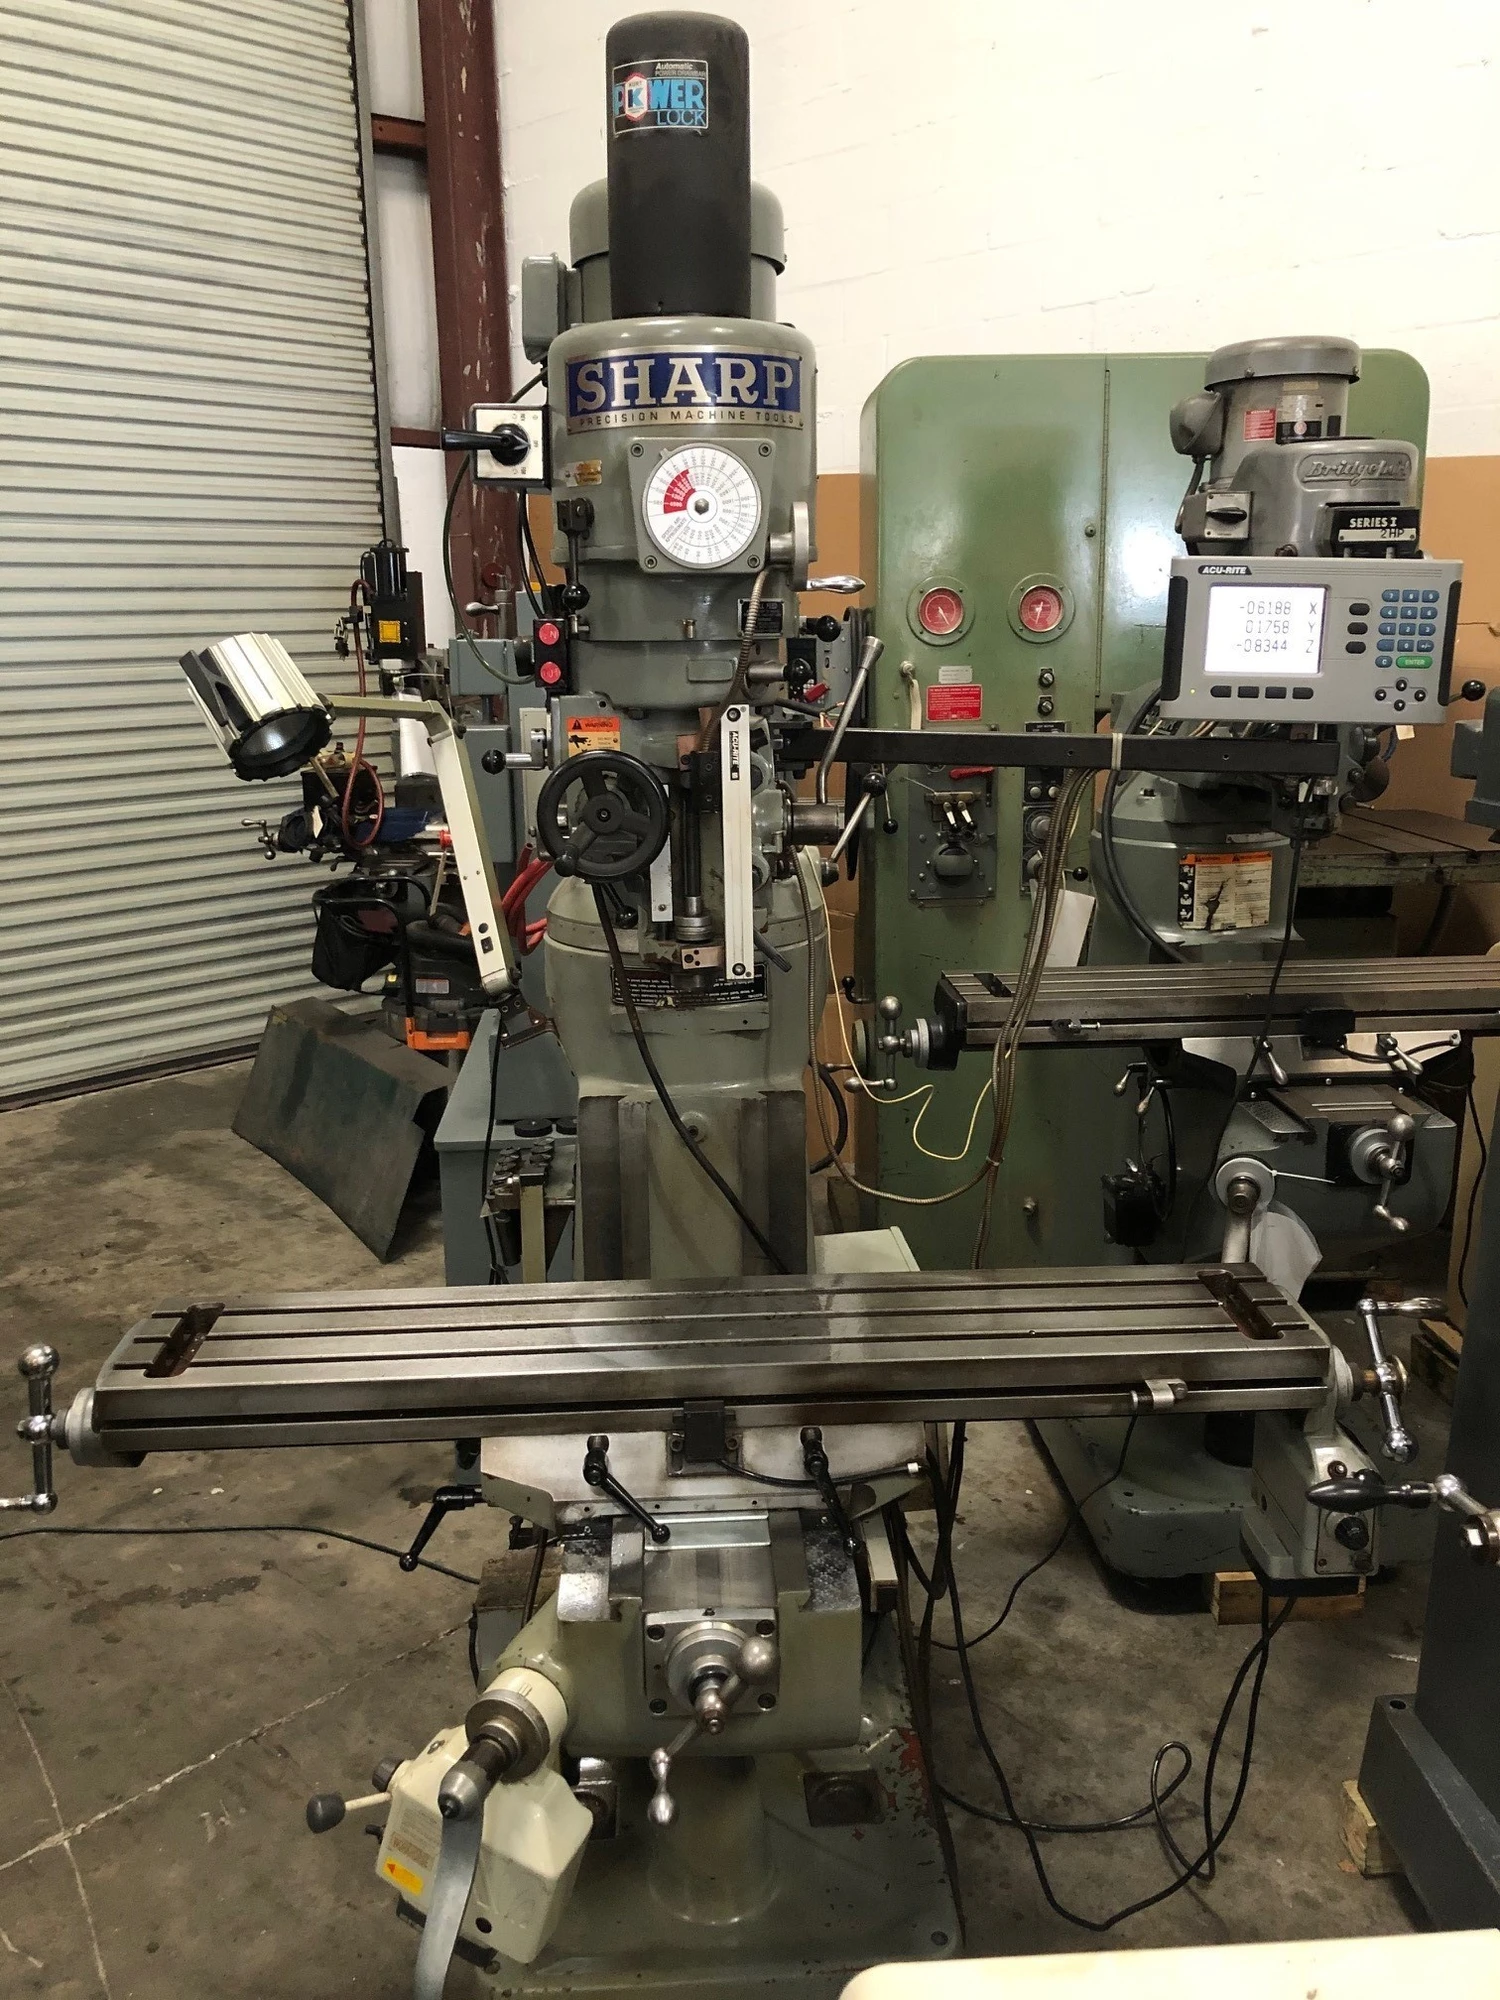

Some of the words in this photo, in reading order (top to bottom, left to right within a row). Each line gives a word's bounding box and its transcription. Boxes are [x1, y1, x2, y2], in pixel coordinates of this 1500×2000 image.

[657, 110, 706, 126] LOCK
[577, 358, 793, 412] SHARP
[580, 411, 659, 426] PRECISION
[670, 410, 746, 421] MACHINE
[756, 411, 795, 424] TOOLS
[1349, 518, 1388, 528] SERIES
[1390, 517, 1397, 527] I
[1380, 529, 1387, 538] 2
[1388, 529, 1405, 538] HP
[1202, 566, 1248, 575] ACU-RITE
[1309, 602, 1317, 615] X
[1308, 621, 1315, 633] Y
[1306, 640, 1314, 653] Z
